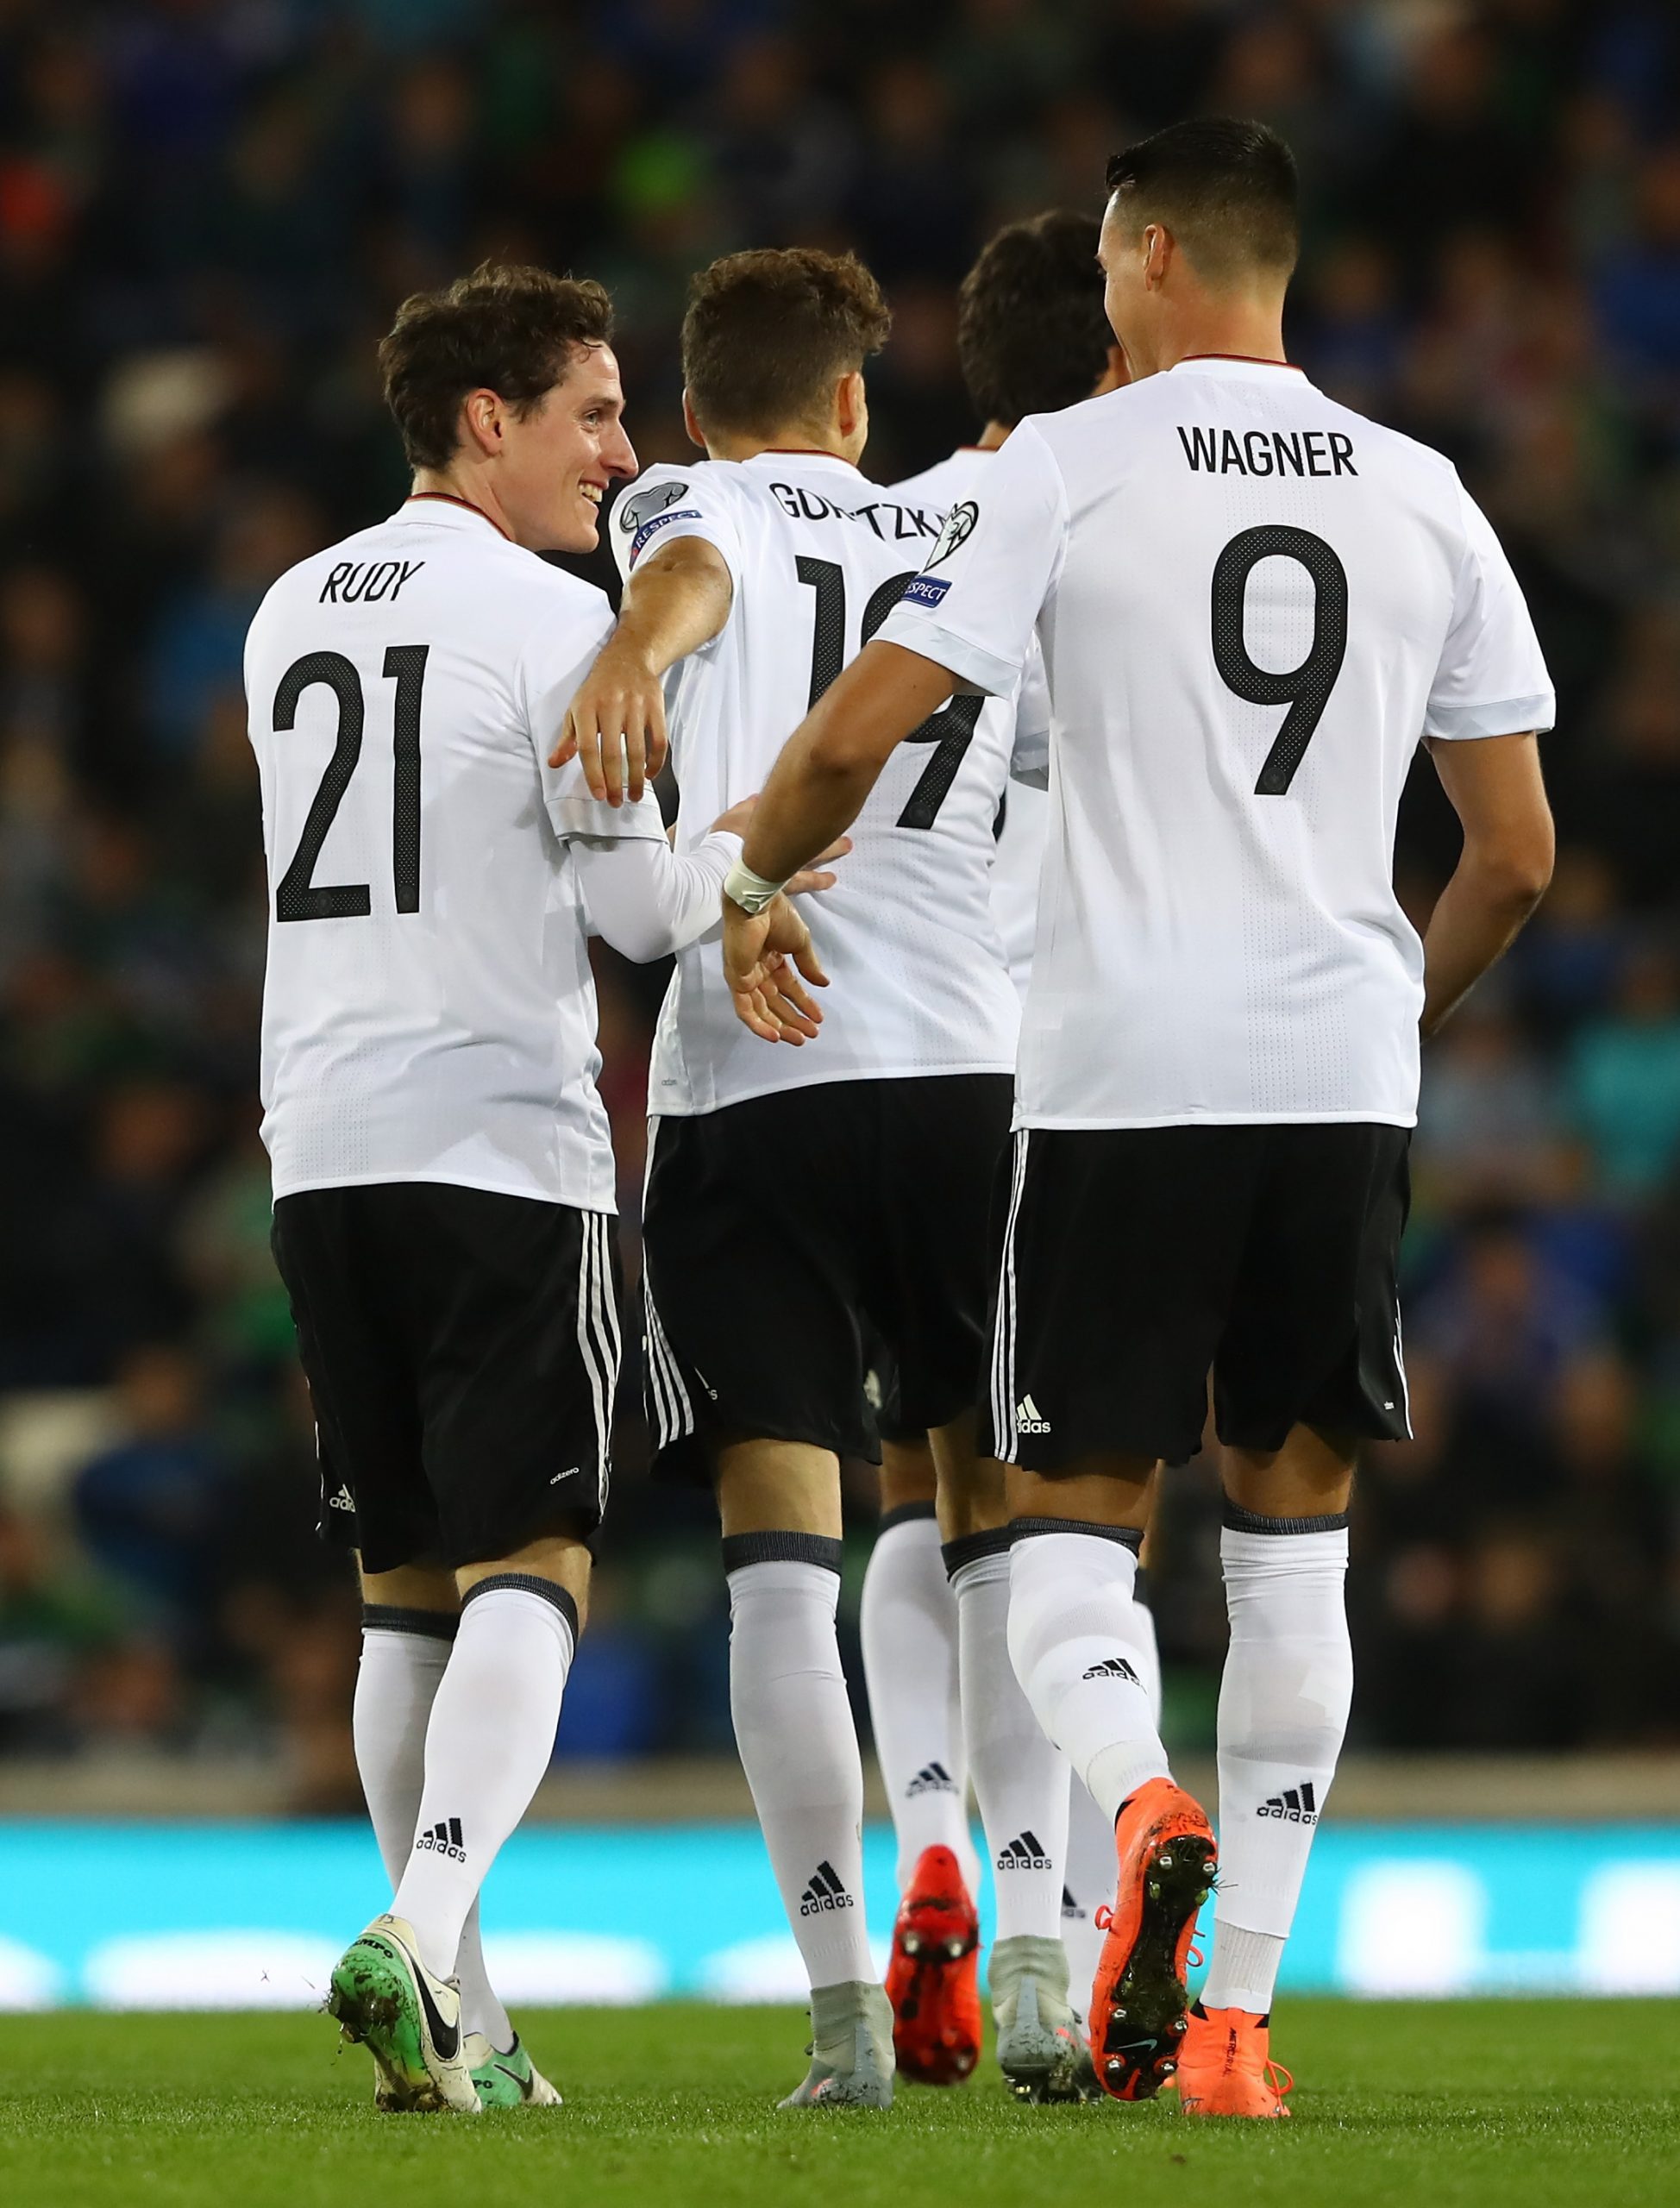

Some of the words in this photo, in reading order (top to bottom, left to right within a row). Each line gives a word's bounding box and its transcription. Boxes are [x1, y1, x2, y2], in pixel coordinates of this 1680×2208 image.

[1176, 425, 1359, 477] WAGNER
[318, 561, 425, 604] RUDY
[1211, 524, 1349, 795] 9
[272, 644, 430, 922] 21
[1017, 1419, 1052, 1433] idas
[1256, 1805, 1319, 1826] adidas
[416, 1837, 467, 1864] adidas
[997, 1856, 1052, 1870] adidas
[799, 1894, 855, 1916] adidas
